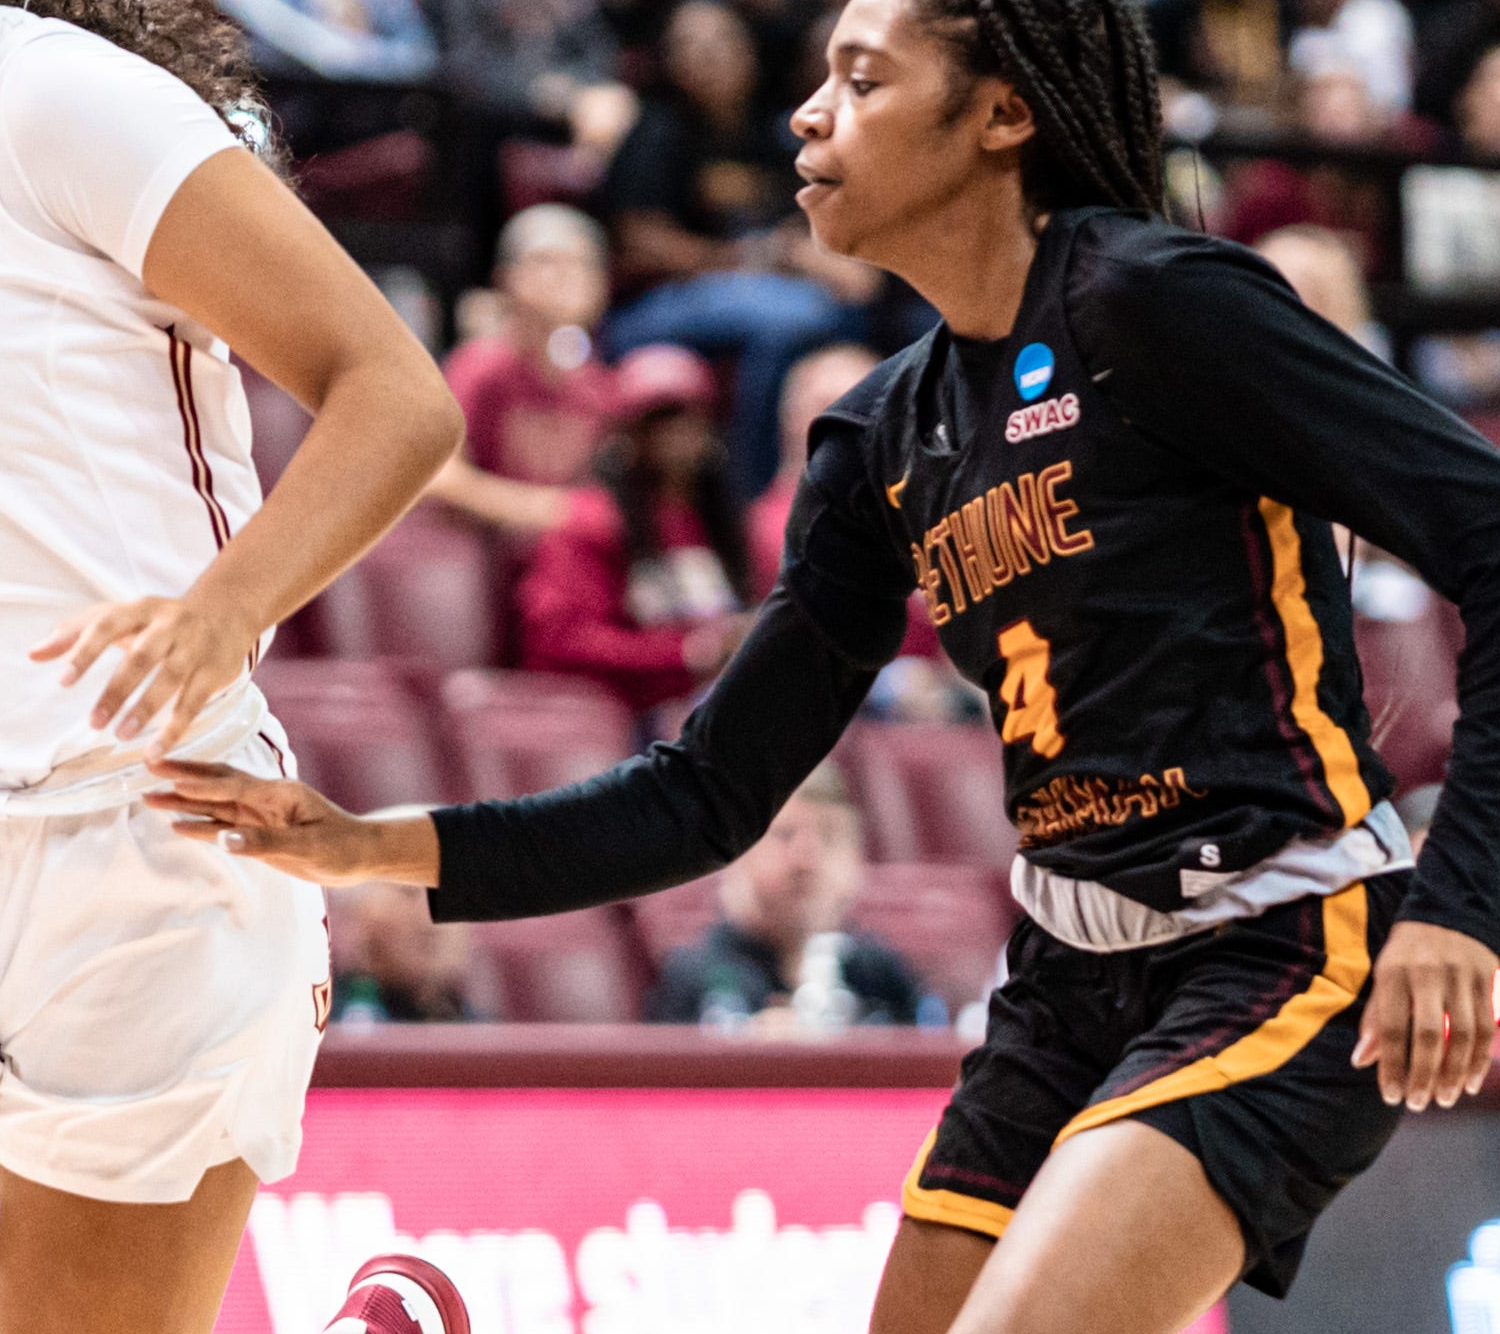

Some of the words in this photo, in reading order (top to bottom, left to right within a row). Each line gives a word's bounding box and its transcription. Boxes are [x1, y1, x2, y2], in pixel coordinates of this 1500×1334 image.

[1005, 392, 1081, 444] SWAC
[997, 617, 1067, 760] 4
[1199, 842, 1223, 868] S
